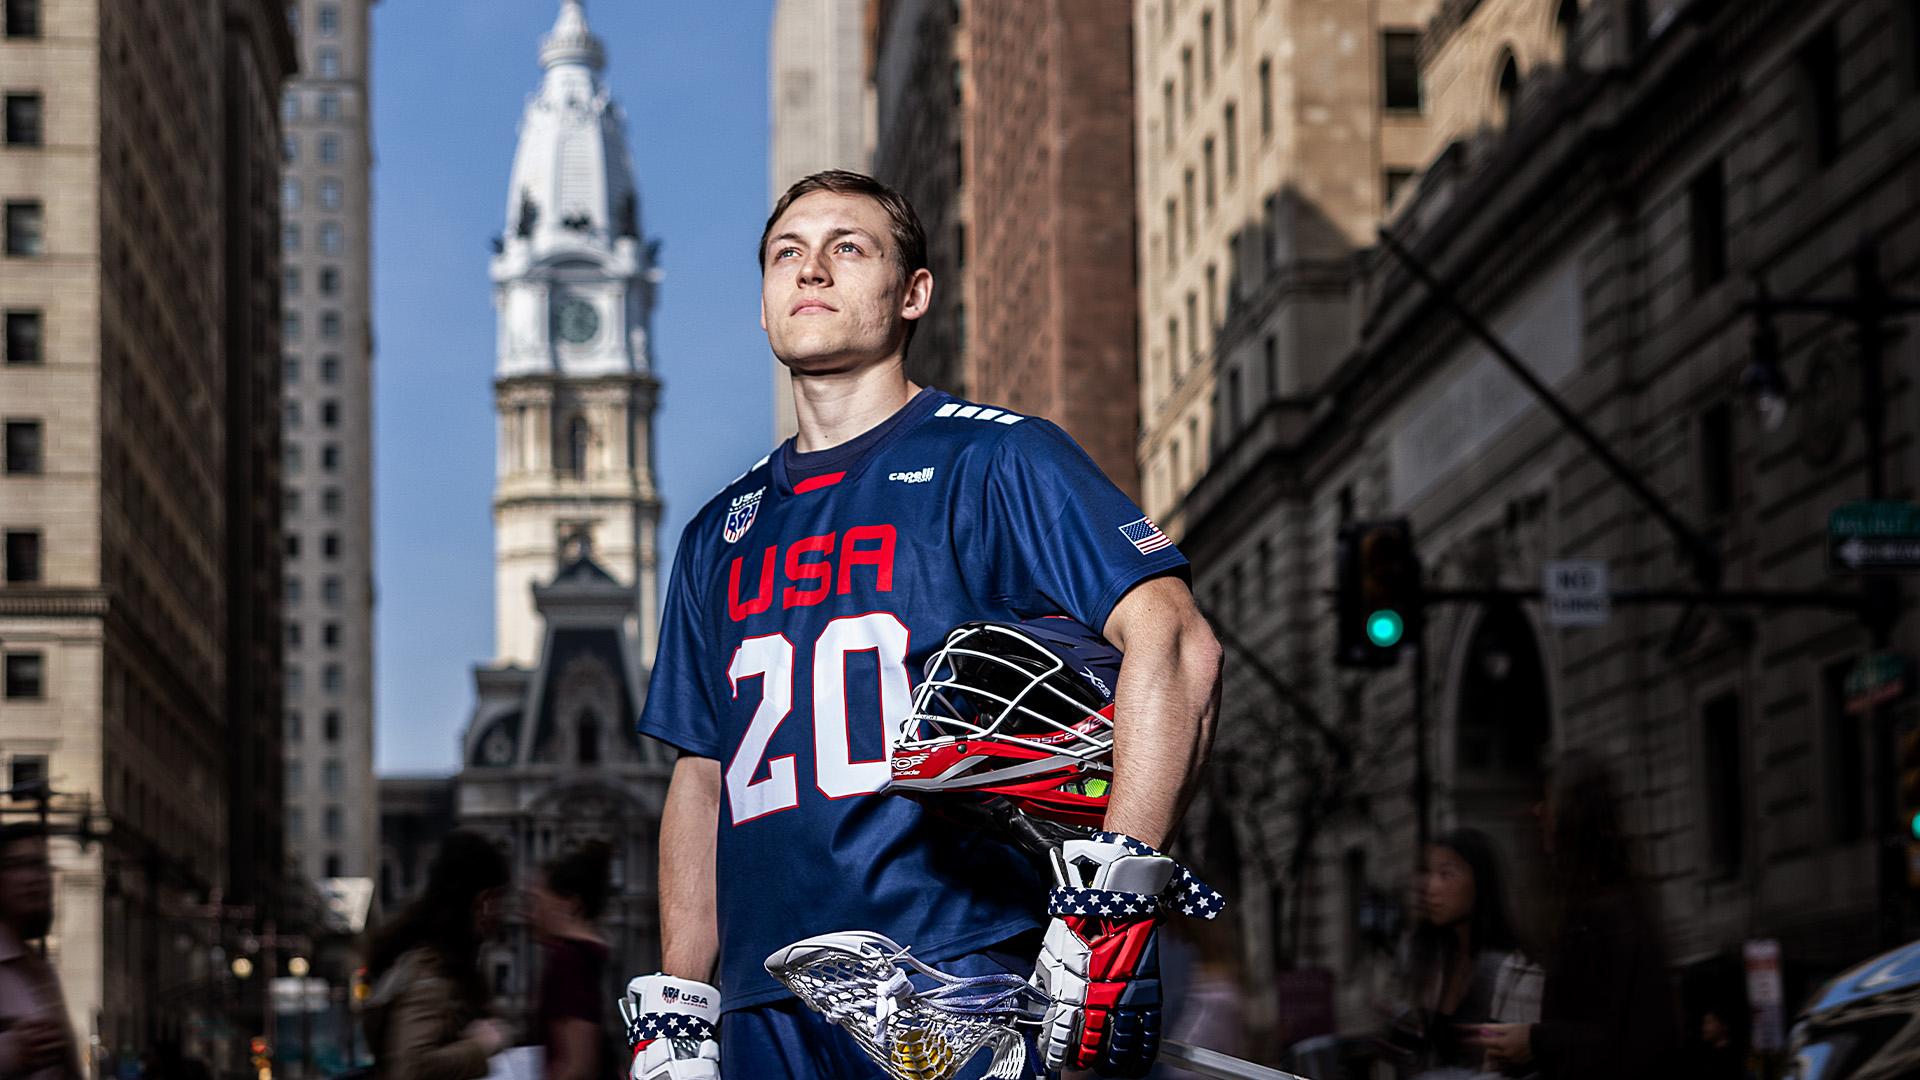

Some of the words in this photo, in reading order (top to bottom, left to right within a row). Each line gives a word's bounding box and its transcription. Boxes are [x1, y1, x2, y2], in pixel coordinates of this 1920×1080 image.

[888, 467, 935, 483] capelli
[731, 488, 763, 507] USA
[728, 523, 897, 622] USA
[725, 610, 921, 827] 20
[681, 993, 708, 1006] USA
